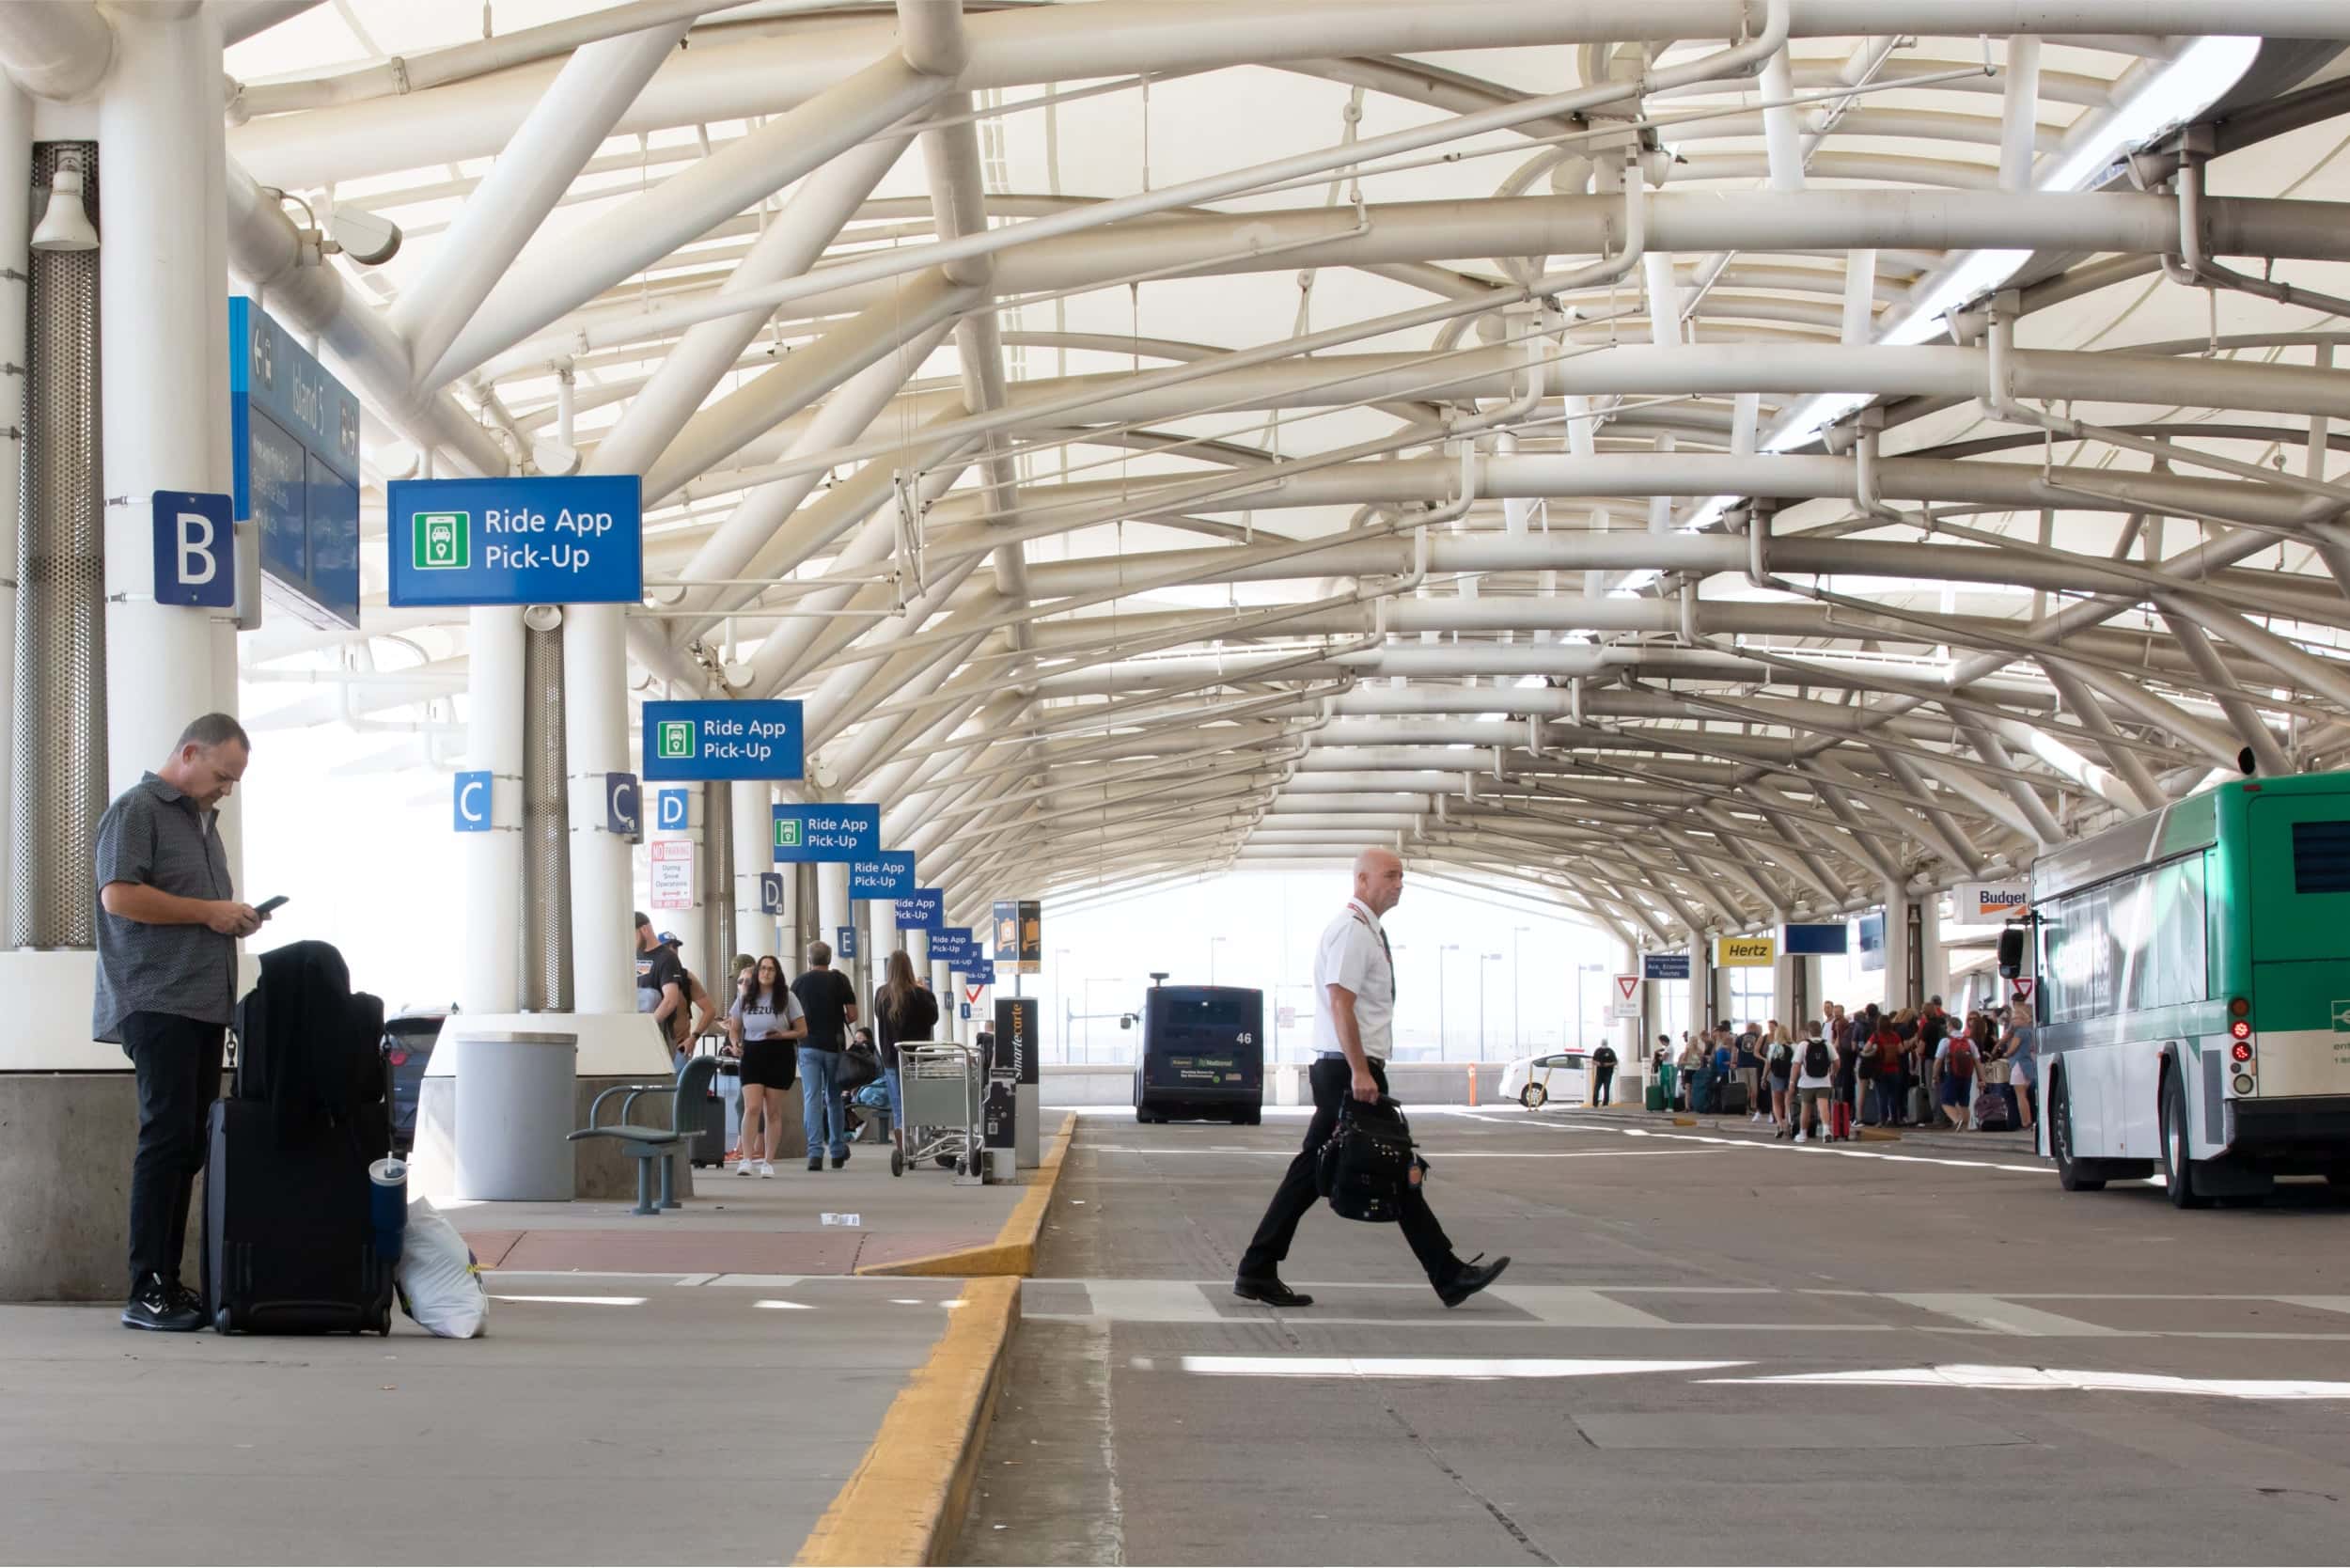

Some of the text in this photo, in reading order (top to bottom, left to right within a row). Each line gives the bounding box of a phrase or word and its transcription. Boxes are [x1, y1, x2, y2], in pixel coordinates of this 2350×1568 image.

[292, 360, 324, 436] Island 5
[485, 509, 613, 538] Ride App
[176, 511, 216, 585] B
[485, 543, 590, 572] Pick-Up
[704, 719, 787, 738] Ride App
[704, 742, 772, 761] Pick-Up
[460, 781, 483, 823] C
[613, 783, 631, 823] C
[664, 796, 683, 823] D
[807, 818, 869, 833] Ride App
[807, 834, 857, 849] Pick-Up
[854, 862, 905, 874] Ride App
[854, 875, 897, 888] Pick-Up
[765, 880, 780, 907] D
[1980, 889, 2027, 907] Budget
[895, 899, 935, 911] Ride App
[895, 910, 929, 921] Pick-Up
[842, 932, 852, 952] E
[950, 935, 966, 945] App
[1729, 944, 1768, 956] Hertz
[1011, 1002, 1023, 1081] smartecarte
[1236, 1032, 1252, 1044] 46
